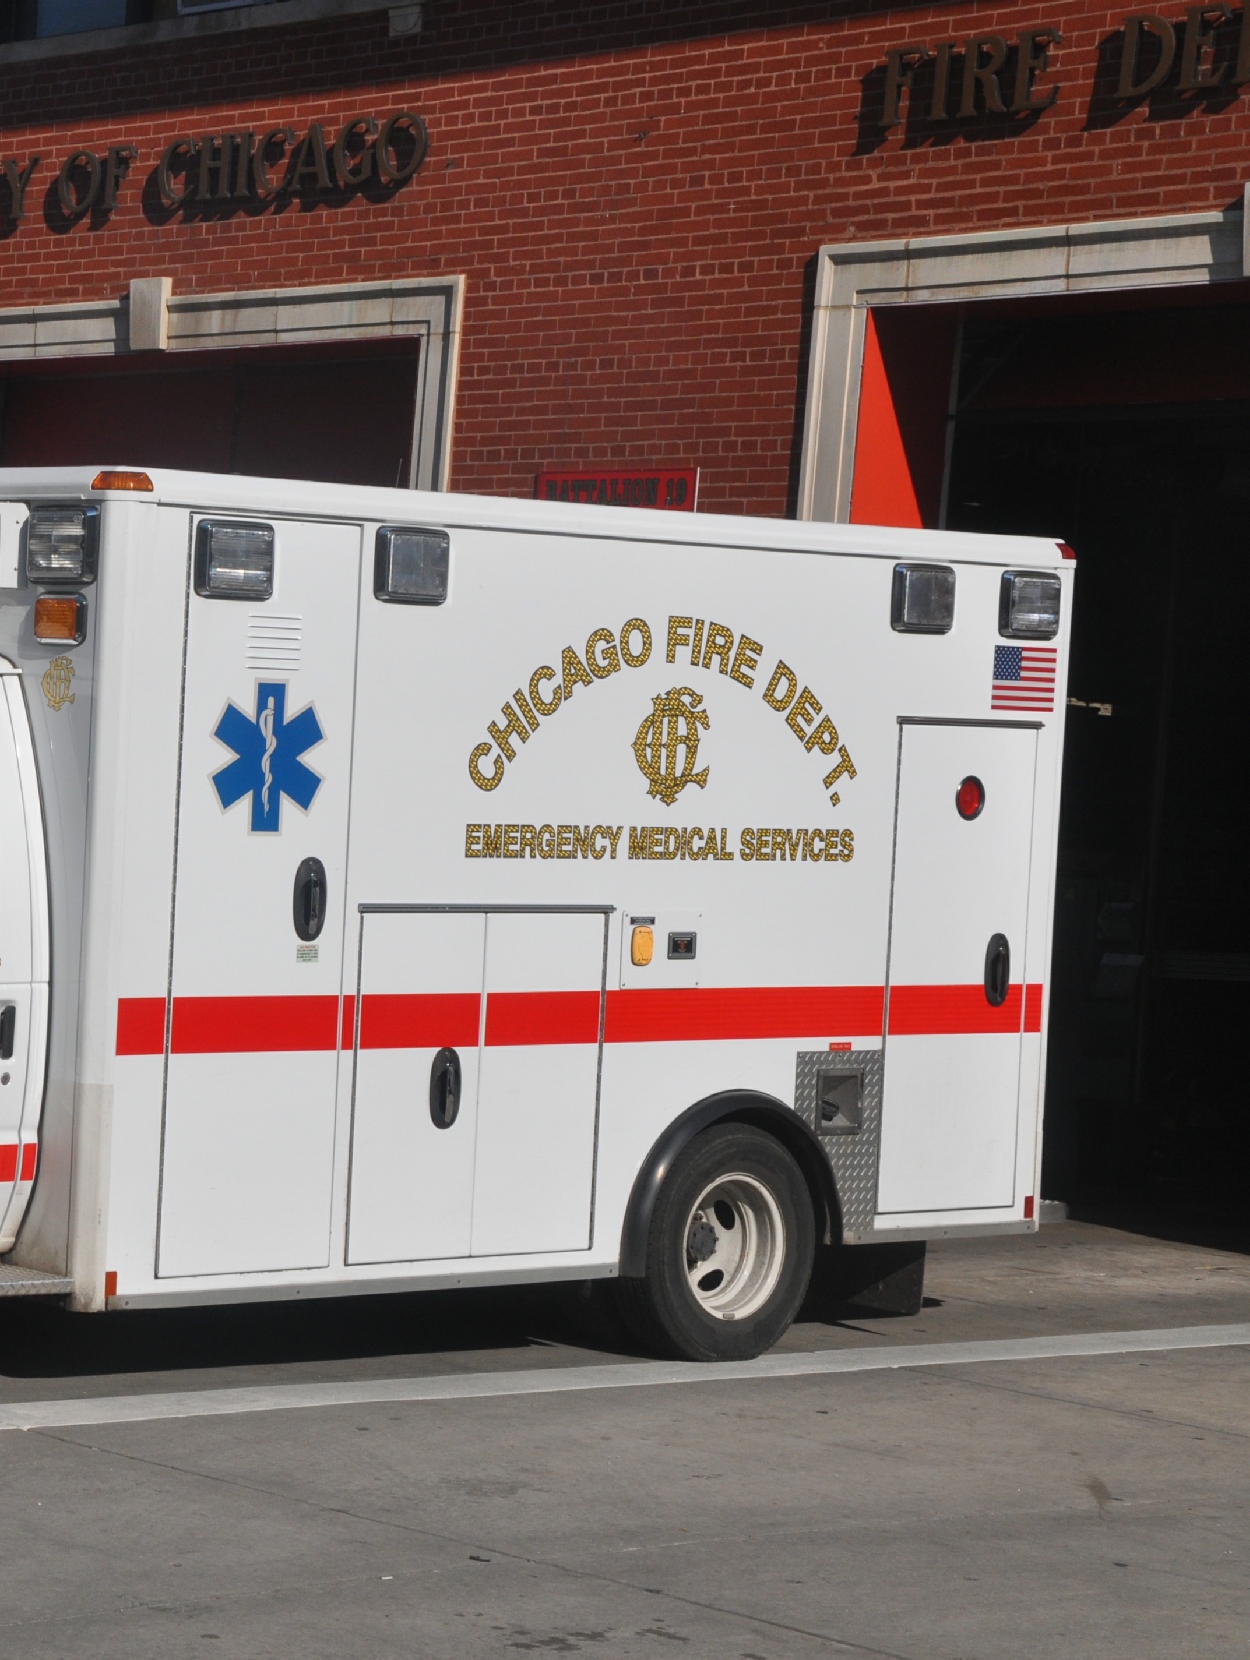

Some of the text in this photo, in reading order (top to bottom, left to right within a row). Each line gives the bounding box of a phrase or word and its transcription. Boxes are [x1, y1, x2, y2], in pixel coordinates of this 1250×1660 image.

[879, 0, 1250, 126] FIRE DE
[57, 145, 138, 214] OF
[157, 111, 429, 201] CHICAGO
[546, 477, 688, 506] BATTALION 19
[468, 615, 858, 807] CHICAGO FIRE DEPT.
[464, 823, 855, 863] EMERGENCY MEDICAL SERVICES
